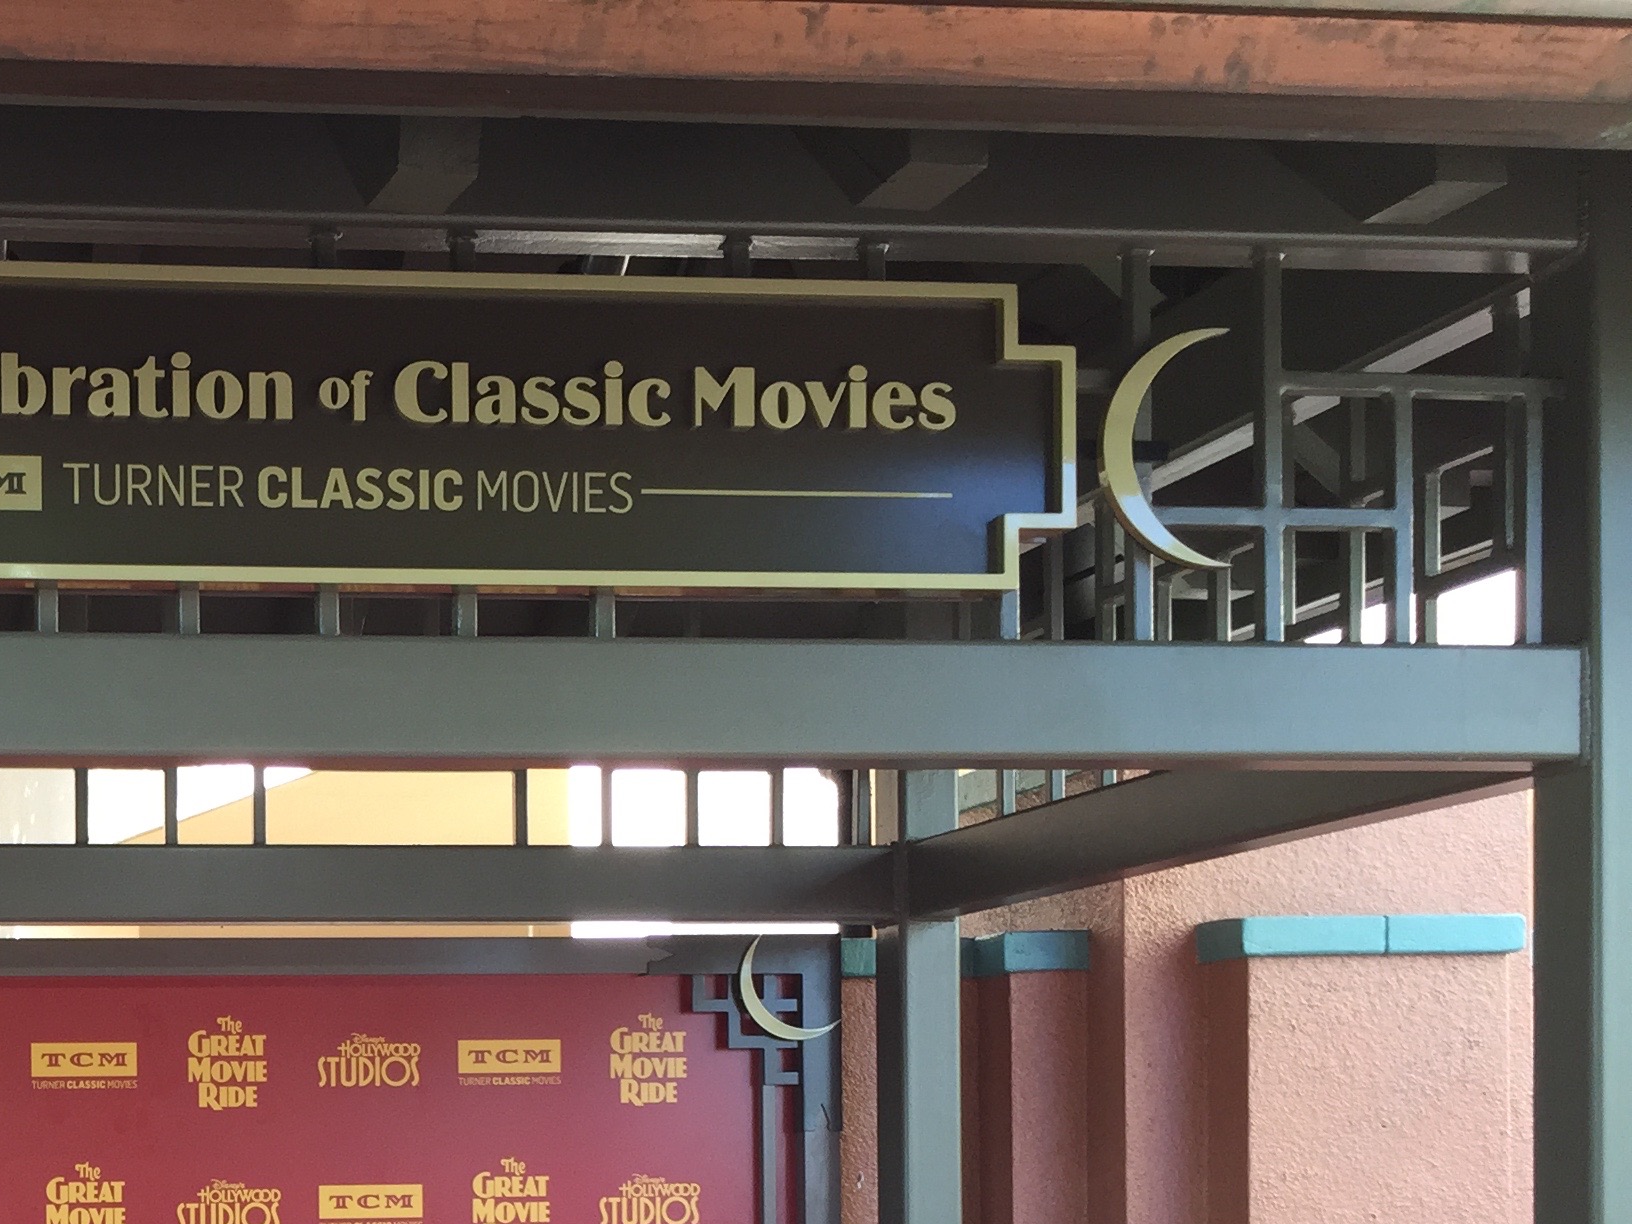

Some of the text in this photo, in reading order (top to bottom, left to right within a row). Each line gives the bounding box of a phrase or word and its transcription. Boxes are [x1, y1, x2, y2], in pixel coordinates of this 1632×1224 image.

[318, 370, 371, 422] of
[393, 360, 672, 430] Classic
[692, 362, 958, 434] Movies
[63, 462, 245, 510] TURNER
[257, 466, 465, 512] CLASSIC
[476, 470, 635, 514] MOVIES
[637, 1013, 662, 1031] The
[188, 1031, 266, 1058] GREAT
[338, 1041, 421, 1059] HOLLYWOOD
[610, 1029, 684, 1056] GREAT
[42, 1053, 126, 1067] TCM
[188, 1057, 267, 1084] MOVIE
[468, 1050, 551, 1064] TCM
[610, 1054, 685, 1080] MOVIE
[318, 1056, 420, 1087] STUDIOS
[199, 1082, 259, 1110] RIDE
[620, 1078, 678, 1105] RIDE
[75, 1161, 101, 1180] The
[46, 1178, 125, 1206] GREAT
[472, 1172, 548, 1200] GREAT
[619, 1183, 699, 1200] HOLLYWOOD
[329, 1194, 413, 1209] TCM
[472, 1198, 549, 1224] MOVIE
